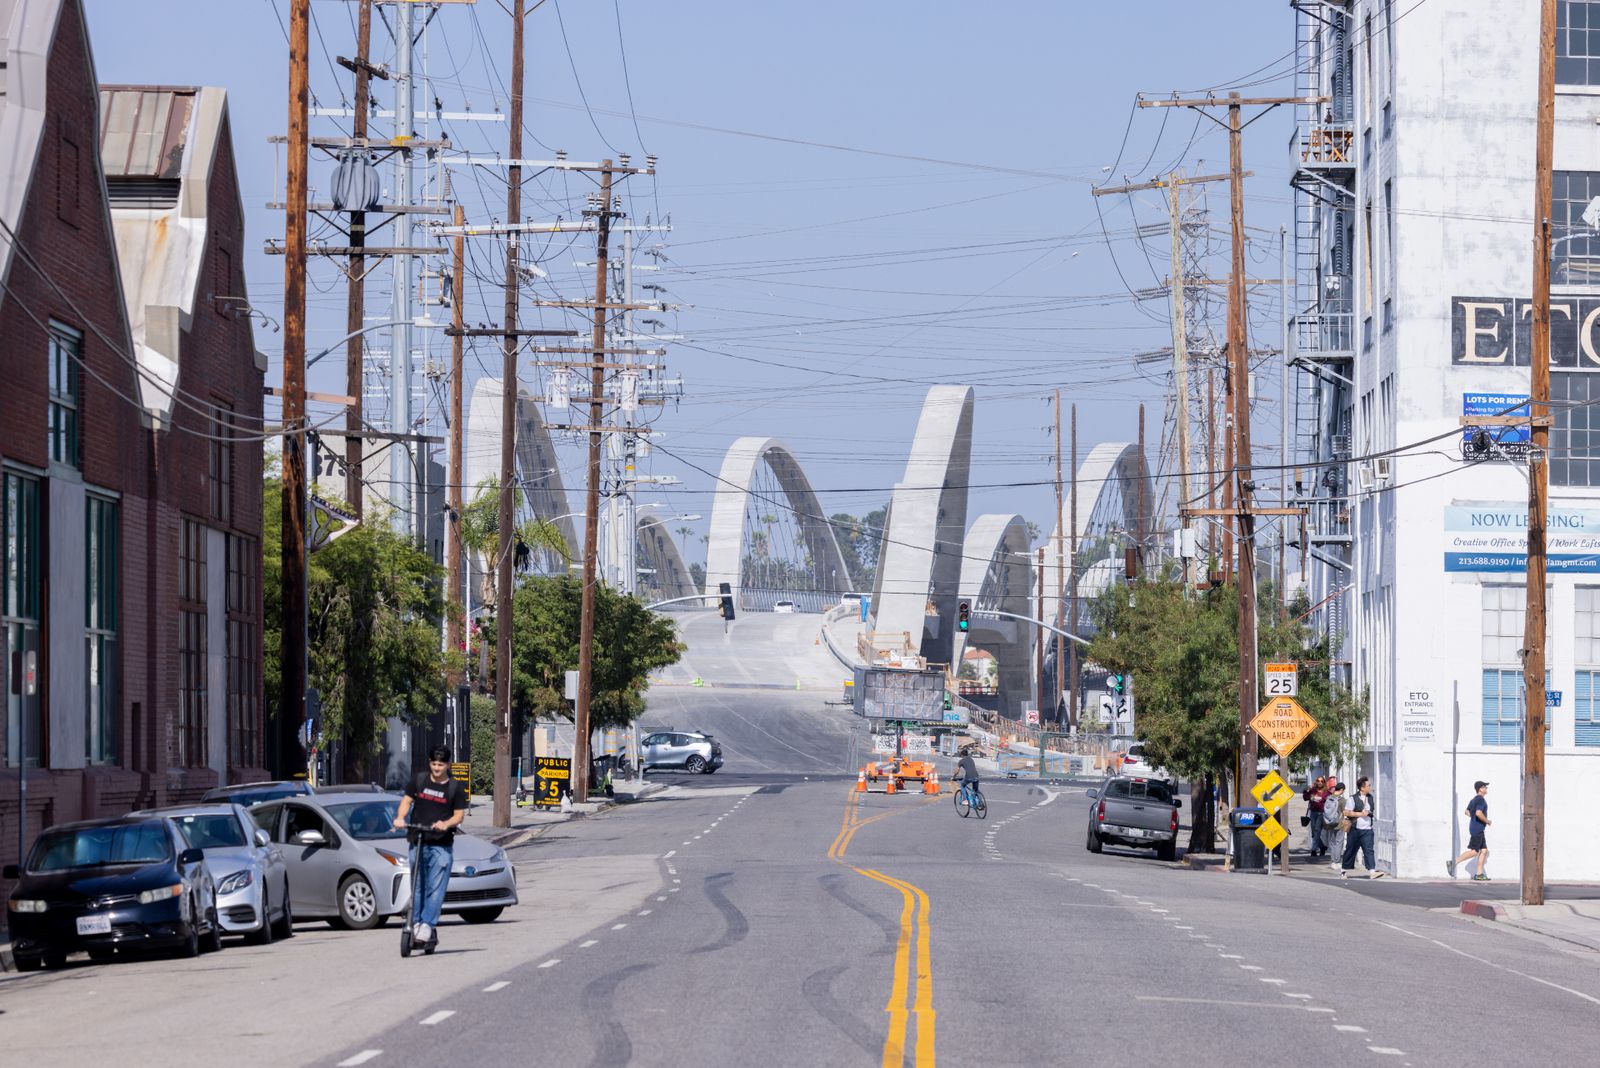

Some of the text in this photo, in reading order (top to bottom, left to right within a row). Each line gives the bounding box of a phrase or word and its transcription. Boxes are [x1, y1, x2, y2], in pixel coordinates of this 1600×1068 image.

[1466, 396, 1487, 404] LOTS
[1488, 397, 1505, 405] FOR
[1471, 514, 1584, 528] NOW LESING!
[1453, 537, 1488, 547] Creative
[1490, 538, 1516, 548] Office
[1555, 538, 1579, 548] Work
[1458, 557, 1510, 566] 213.688.9190
[1270, 679, 1292, 694] 25
[1409, 692, 1429, 700] ETO
[1257, 719, 1310, 728] CONSTRUCTION
[1272, 731, 1296, 740] AHEAD
[538, 759, 568, 767] PUBLIC
[549, 781, 559, 797] 5
